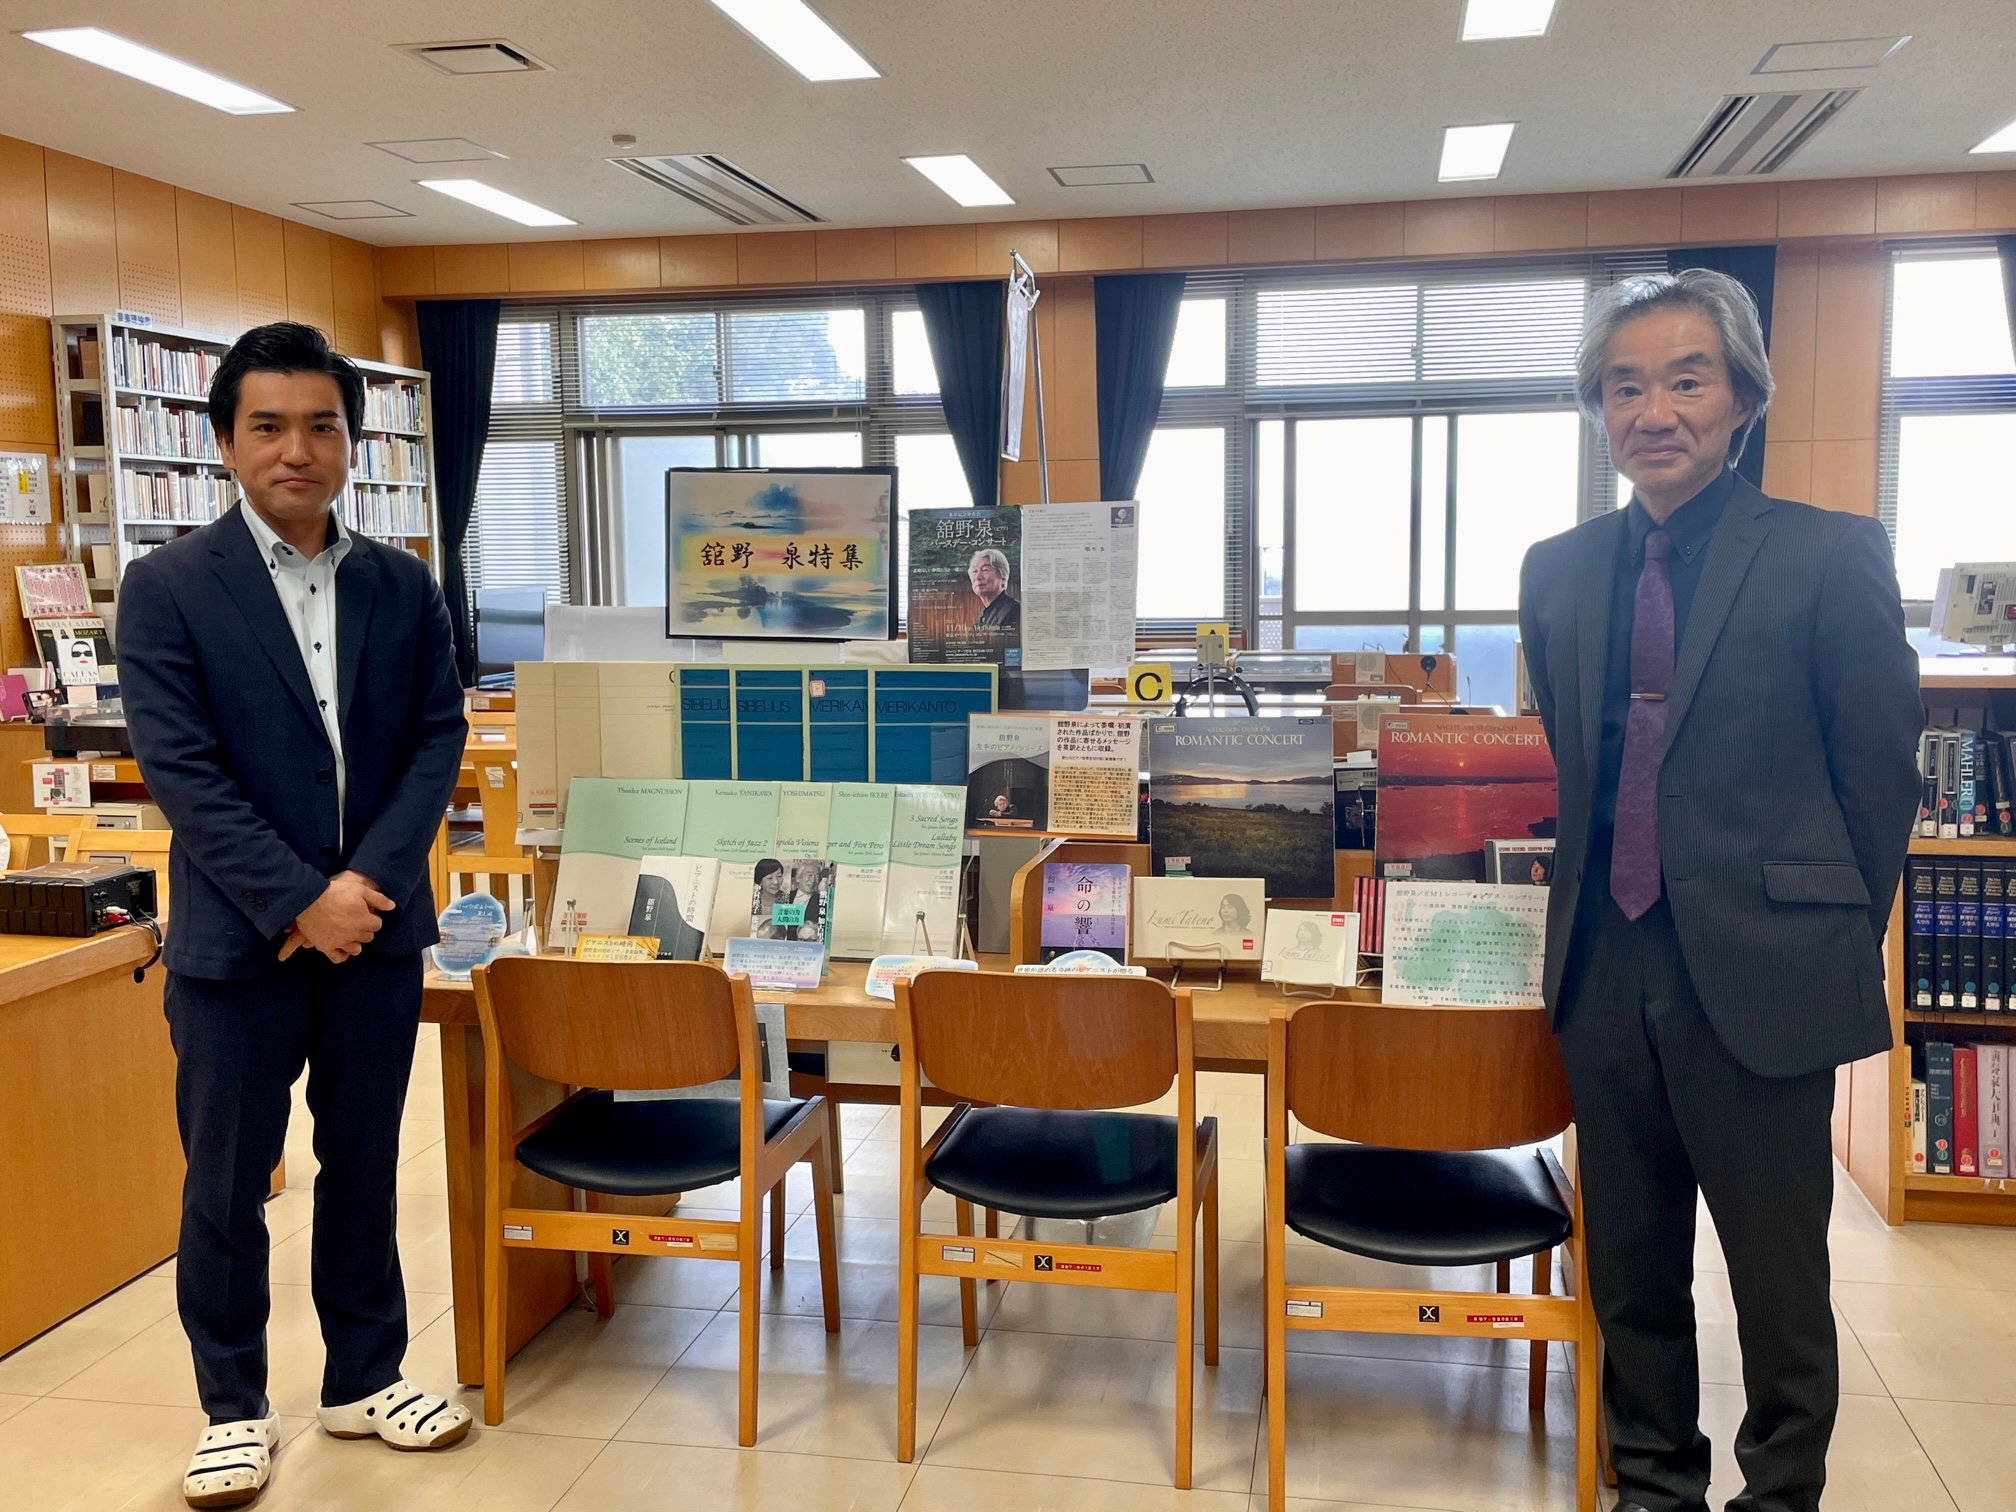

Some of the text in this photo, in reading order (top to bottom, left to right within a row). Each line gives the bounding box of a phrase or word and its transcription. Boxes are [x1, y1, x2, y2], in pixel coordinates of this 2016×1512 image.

[936, 519, 993, 539] 舘野泉
[701, 542, 864, 570] 舘野 泉特集
[63, 670, 98, 678] CALLAS
[1135, 672, 1163, 701] C
[737, 700, 791, 713] SIBELIUS
[875, 701, 957, 713] MERIKANTO
[1056, 737, 1131, 745] の作品に寄せるメッセージ
[1175, 734, 1305, 746] ROMANTIC CONCERT
[1391, 732, 1544, 746] ROMANTIC CONCERT
[976, 743, 1043, 752] 左手のピアノ・シリーズ
[1056, 744, 1115, 752] を英訳とともに収録。
[1960, 737, 1974, 797] MAHLER
[739, 789, 773, 797] TANIKAWA
[909, 814, 959, 825] 3 Sacred Songs
[623, 836, 678, 846] Scenes of Iceland
[715, 838, 769, 848] Sketch of Jazz 2
[795, 839, 820, 847] Visions
[931, 833, 958, 843] Lullaby
[839, 840, 851, 848] and
[852, 840, 867, 850] Five
[892, 840, 957, 852] Little Dream Songs
[685, 865, 703, 923] ピアニストの時間
[1074, 876, 1094, 935] 命の響
